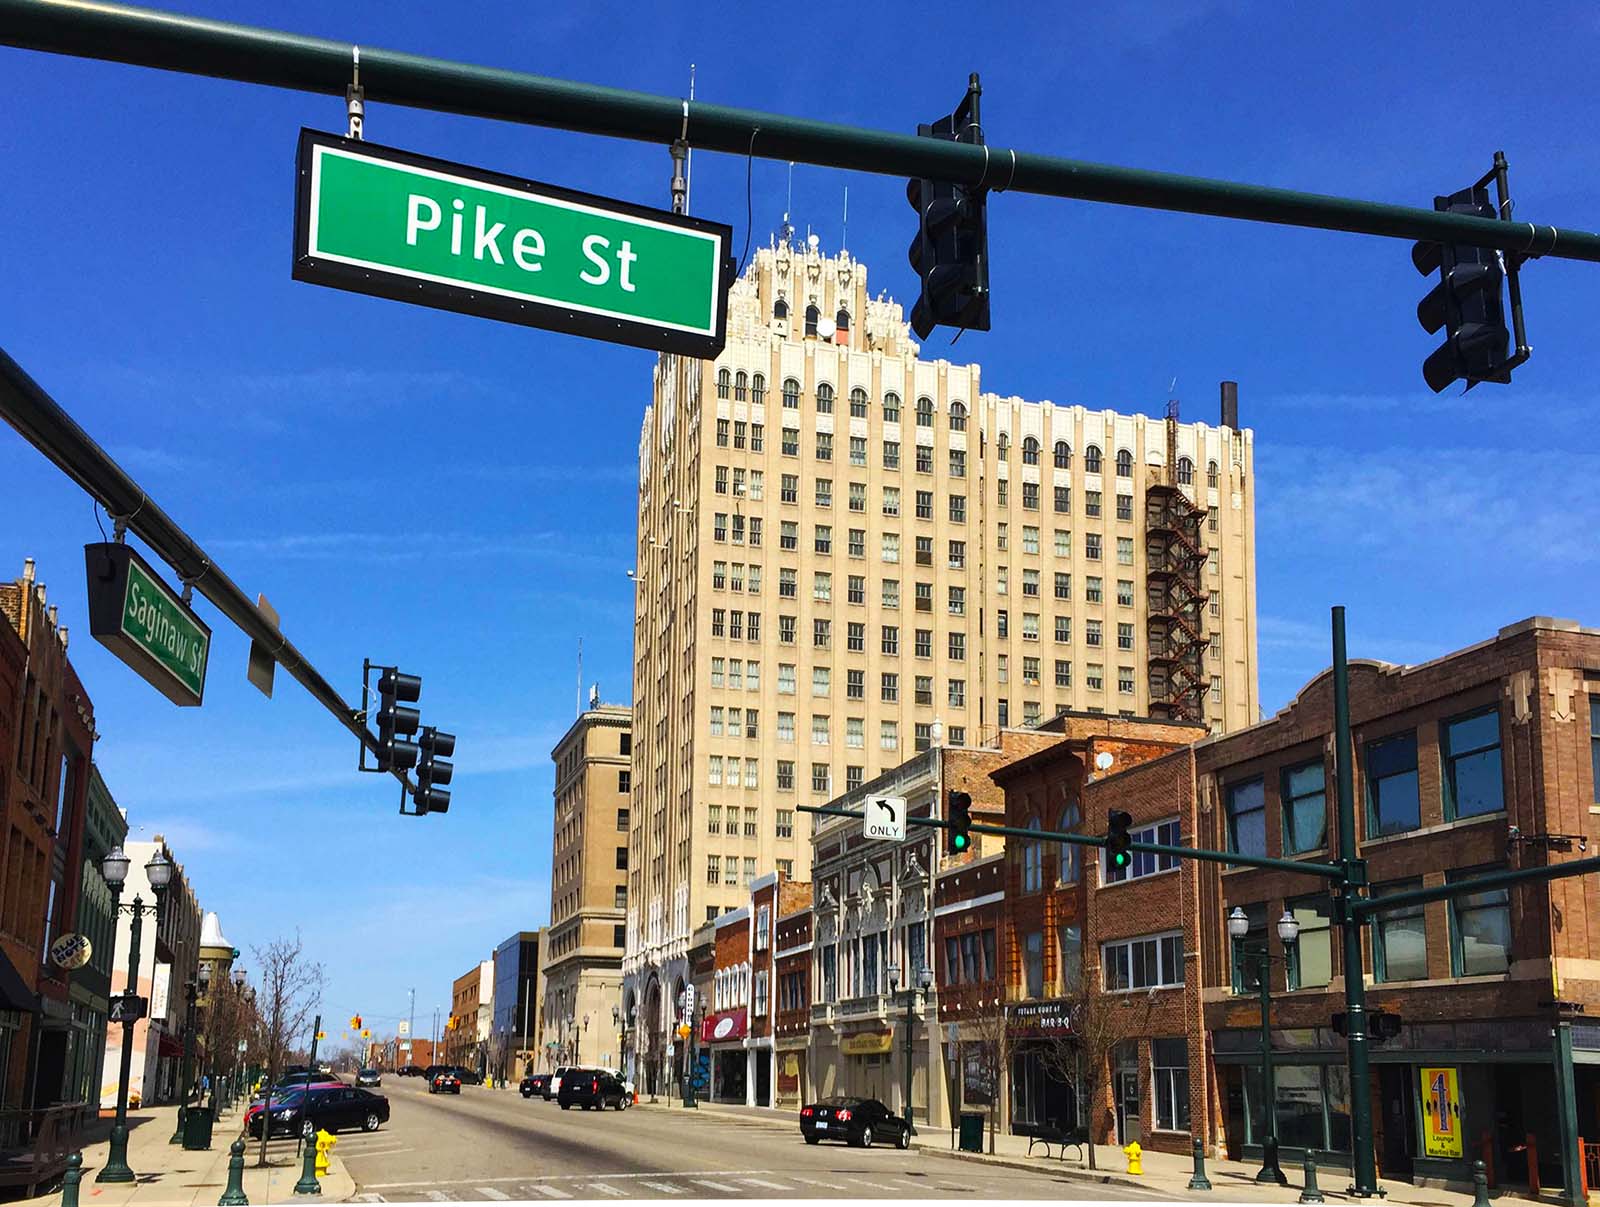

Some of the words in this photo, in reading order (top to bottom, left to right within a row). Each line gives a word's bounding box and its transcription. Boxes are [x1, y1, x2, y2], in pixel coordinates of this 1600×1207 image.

[405, 194, 546, 272] Pike
[579, 234, 638, 293] St
[129, 582, 187, 662] Saginaw
[190, 642, 202, 678] St
[870, 825, 899, 837] ONLY
[52, 935, 83, 955] BLUE
[57, 939, 88, 963] NOTE
[1433, 1135, 1454, 1143] Lounge
